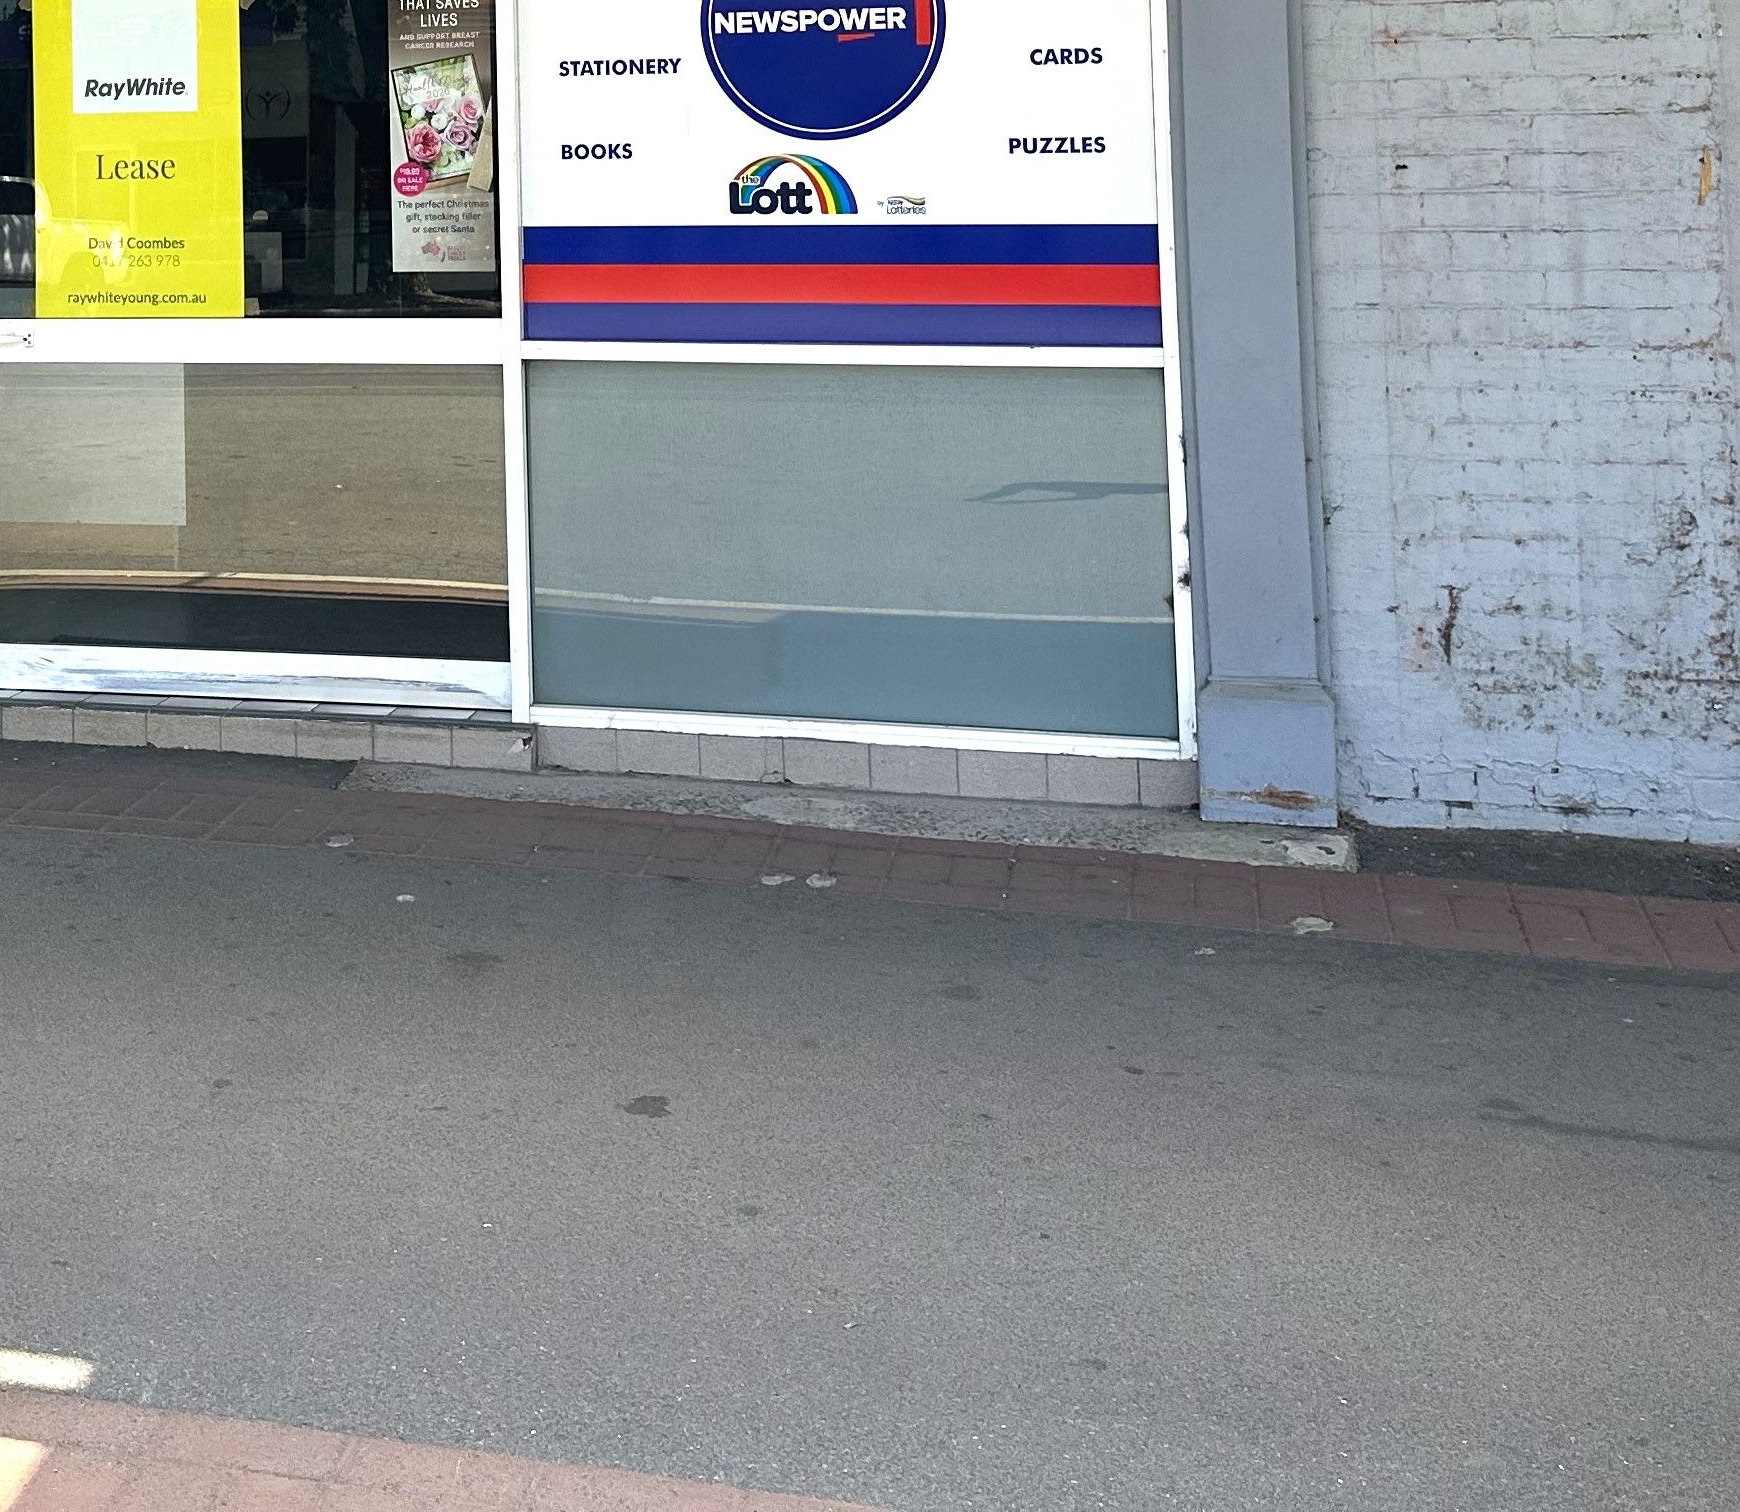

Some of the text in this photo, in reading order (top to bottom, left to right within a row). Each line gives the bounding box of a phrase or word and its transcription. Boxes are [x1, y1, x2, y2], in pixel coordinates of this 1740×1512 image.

[420, 12, 458, 28] LIVES
[714, 6, 907, 35] NEWSPOWER
[451, 31, 480, 39] BREAST
[1029, 47, 1104, 67] CARDS
[558, 57, 682, 77] STATIONERY
[560, 142, 633, 161] BOOKS
[1008, 136, 1107, 156] PUZZLES
[96, 154, 176, 180] Lease
[742, 174, 759, 184] the
[397, 199, 489, 210] The perfect Christmas
[729, 181, 813, 214] Lott
[424, 212, 459, 222] stocking
[887, 206, 926, 214] Lotteries
[423, 225, 449, 233] secret
[450, 225, 475, 233] Santa
[88, 236, 186, 250] Davd Coombes
[129, 255, 153, 268] 263
[156, 254, 180, 268] 978
[67, 291, 207, 305] raywhiteyoung.com.au
